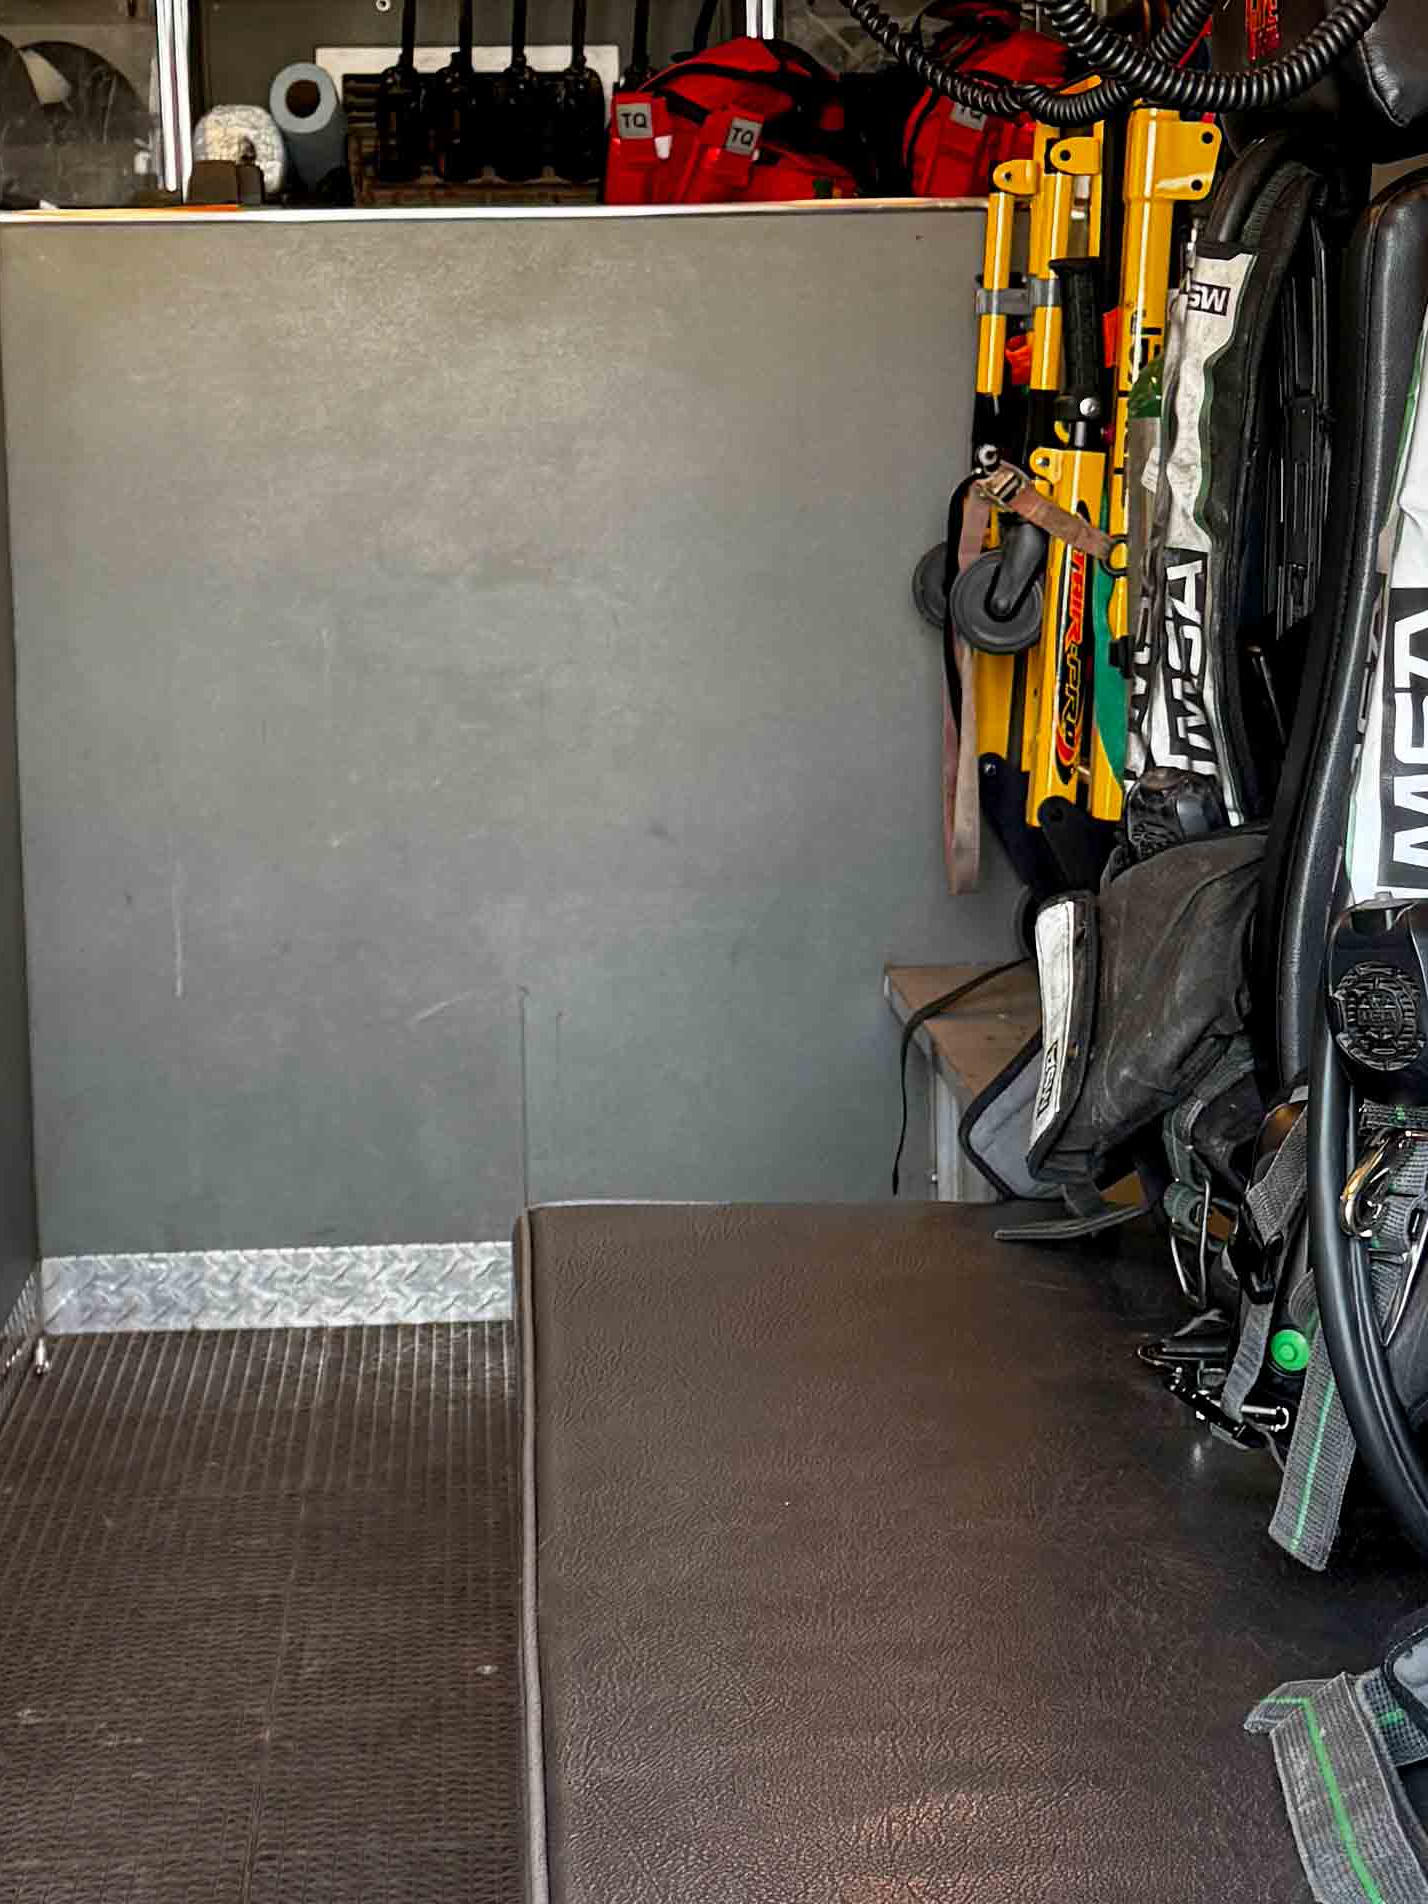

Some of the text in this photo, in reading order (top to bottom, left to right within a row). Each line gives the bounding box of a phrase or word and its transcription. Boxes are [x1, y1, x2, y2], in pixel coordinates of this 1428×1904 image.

[621, 112, 647, 129] TQ
[731, 127, 753, 147] TQ
[1188, 284, 1227, 312] MS
[1061, 549, 1087, 748] TAIR-PRO
